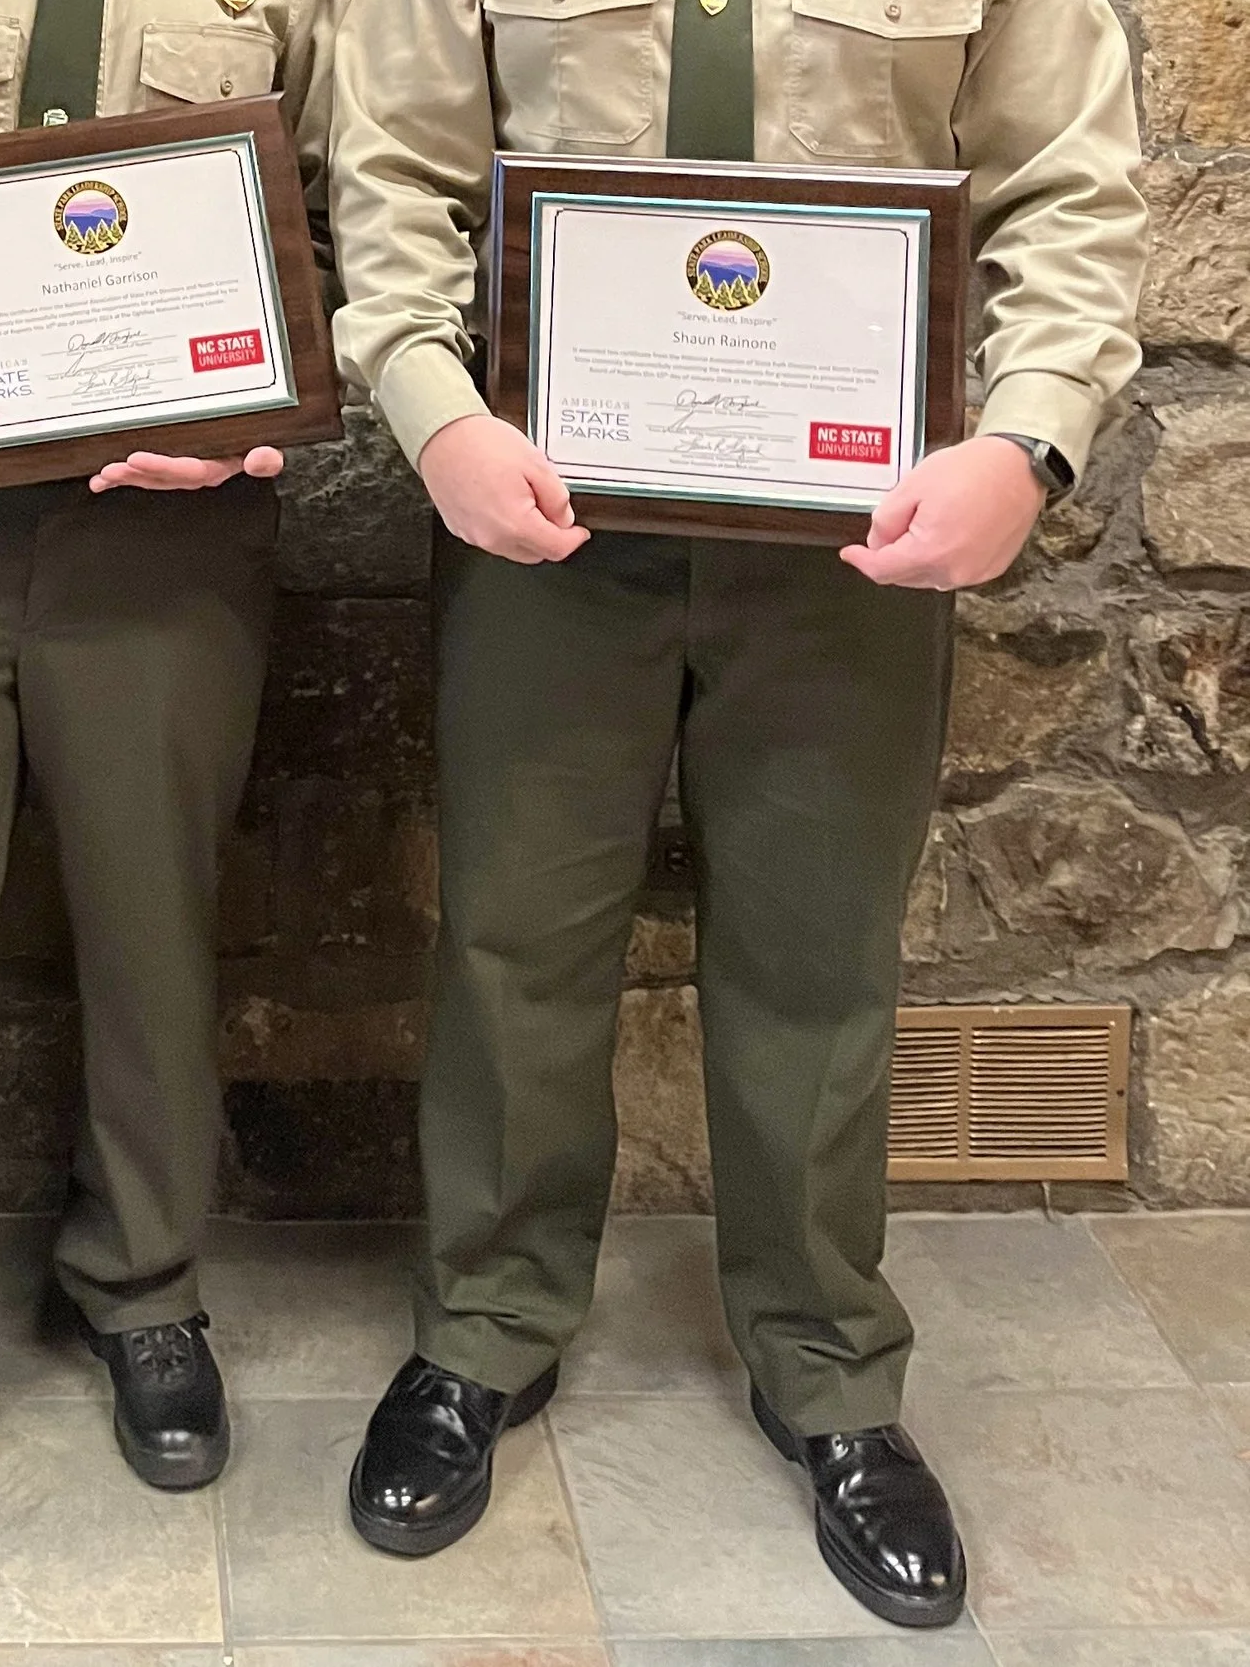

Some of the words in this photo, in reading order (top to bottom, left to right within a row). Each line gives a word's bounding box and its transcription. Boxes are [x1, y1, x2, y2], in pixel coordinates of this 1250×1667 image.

[41, 275, 102, 296] Nathaniel
[105, 270, 159, 287] Garrison
[196, 340, 216, 355] NC
[216, 334, 255, 352] STATE
[672, 330, 716, 346] Shaun
[720, 334, 777, 351] Rainone
[198, 348, 257, 367] UNIVERSITY
[561, 409, 629, 427] STATE
[560, 424, 631, 441] PARKS
[818, 427, 838, 442] NC
[841, 429, 882, 446] STATE
[817, 442, 882, 458] UNIVERSITY
